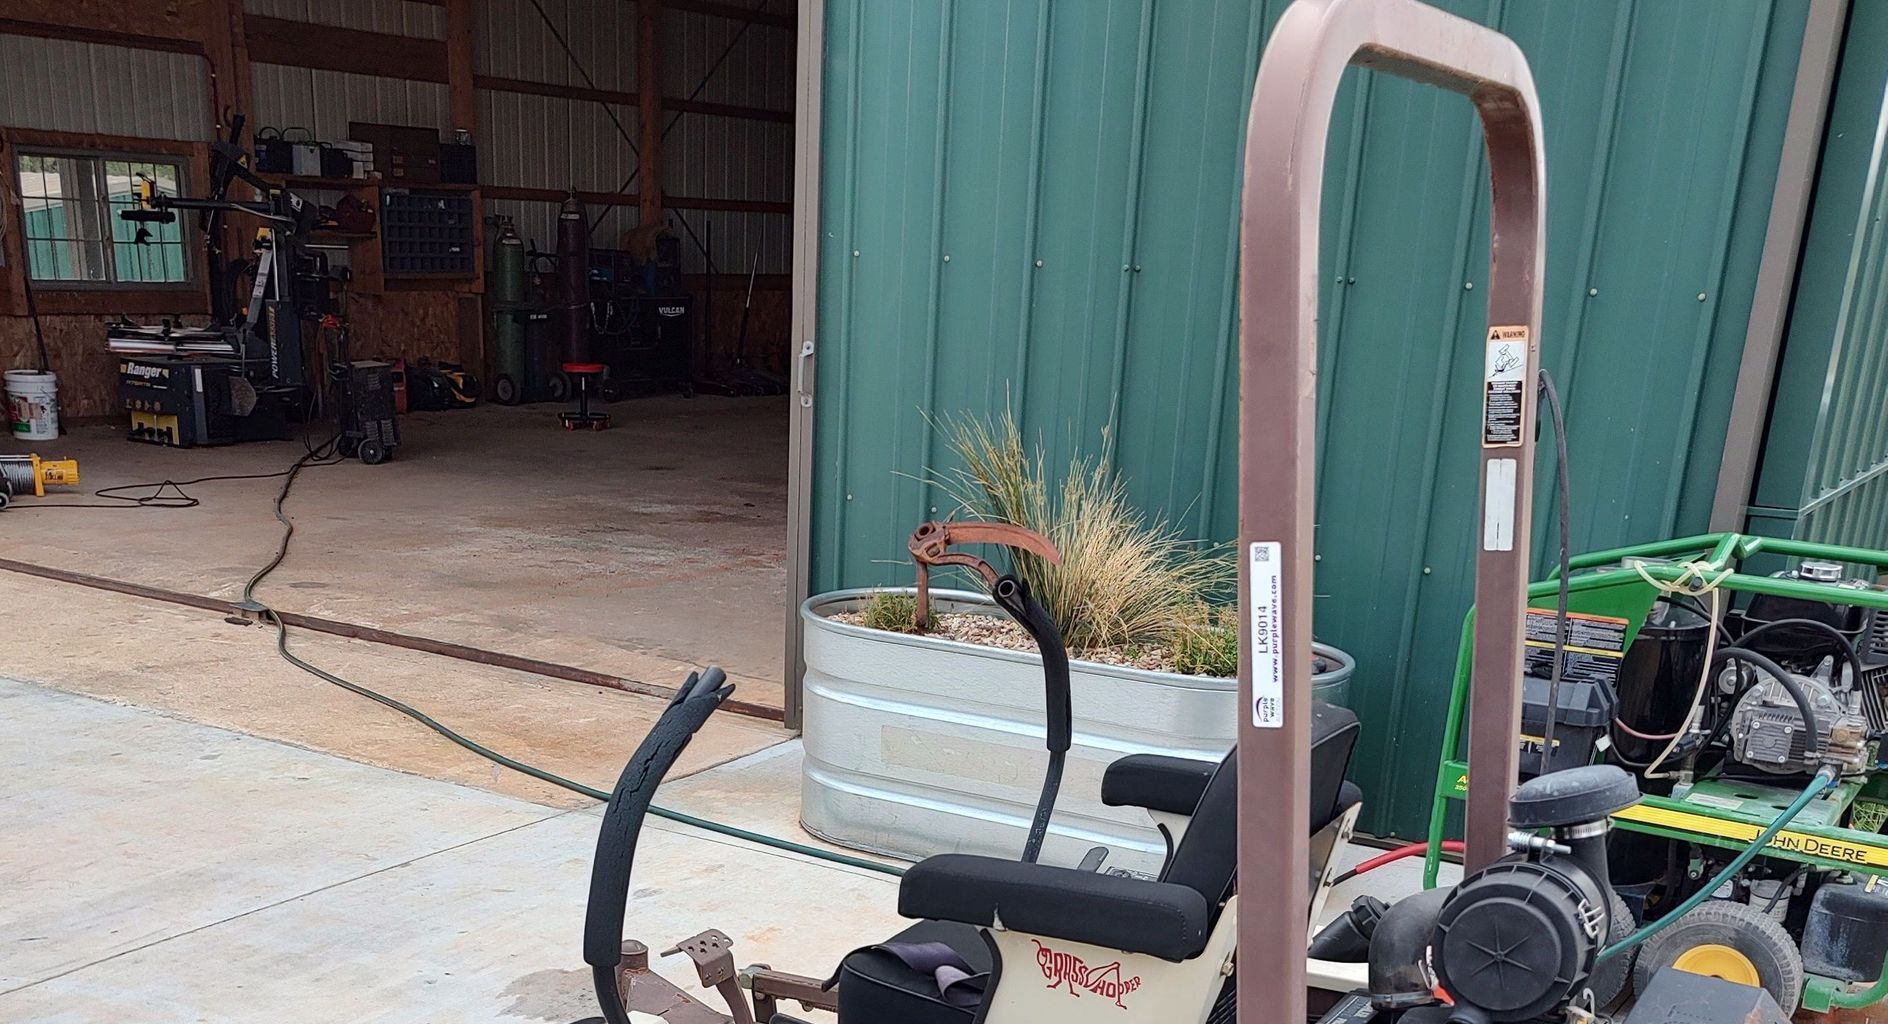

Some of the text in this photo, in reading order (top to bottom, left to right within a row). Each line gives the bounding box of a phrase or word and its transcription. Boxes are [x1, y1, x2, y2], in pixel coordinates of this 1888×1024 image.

[658, 306, 685, 315] VULCAN
[127, 362, 163, 379] Ranger
[1258, 605, 1269, 654] LK9014
[1271, 575, 1279, 683] www.purplewave.com
[1749, 829, 1868, 862] JHN DEERE
[1034, 944, 1141, 1002] GRASSHOPPER
